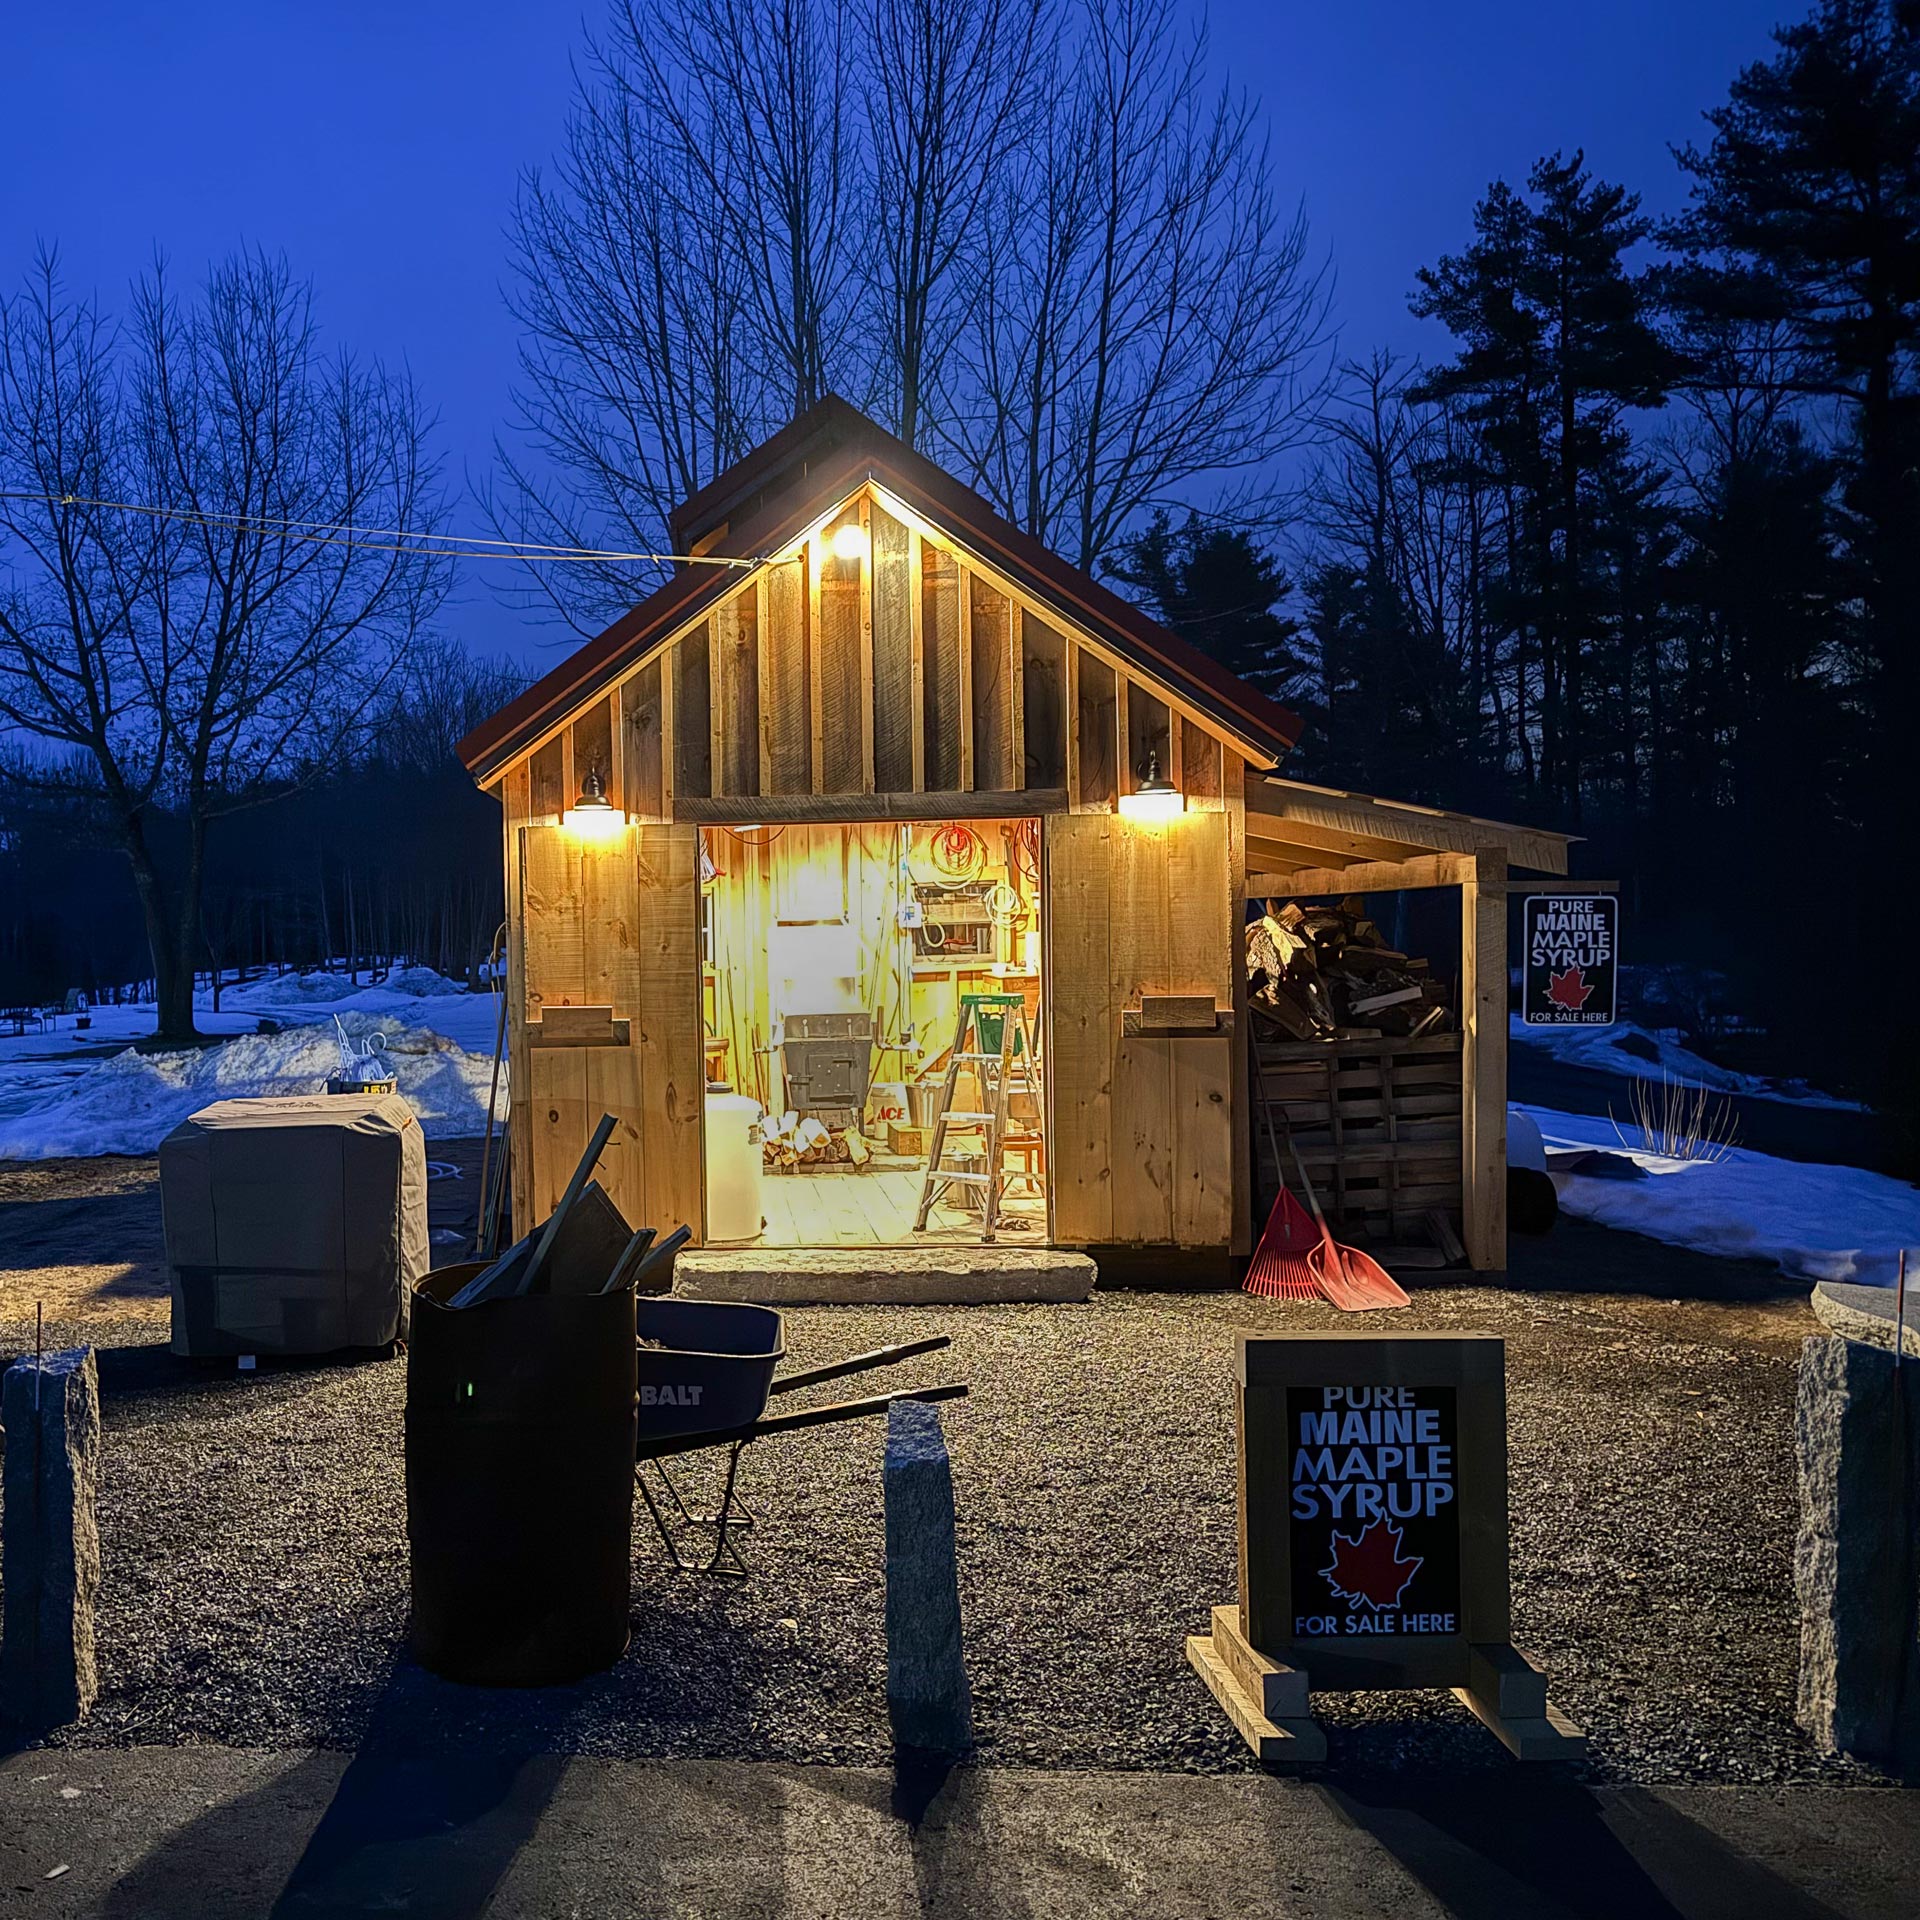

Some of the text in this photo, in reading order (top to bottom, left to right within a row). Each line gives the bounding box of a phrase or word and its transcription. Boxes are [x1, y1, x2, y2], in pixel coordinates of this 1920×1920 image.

[1548, 900, 1594, 913] PURE
[1537, 914, 1605, 931] MAINE
[1532, 931, 1611, 948] MAPLE
[1531, 948, 1611, 966] SYRUP
[1530, 1012, 1608, 1022] FOR SALE HERE
[877, 1105, 906, 1121] ACE
[1323, 1386, 1416, 1409] PURE
[1300, 1410, 1440, 1445] MAINE
[1292, 1446, 1452, 1482] MAPLE
[1292, 1482, 1454, 1519] SYRUP
[1295, 1613, 1455, 1634] FOR SALE HERE
